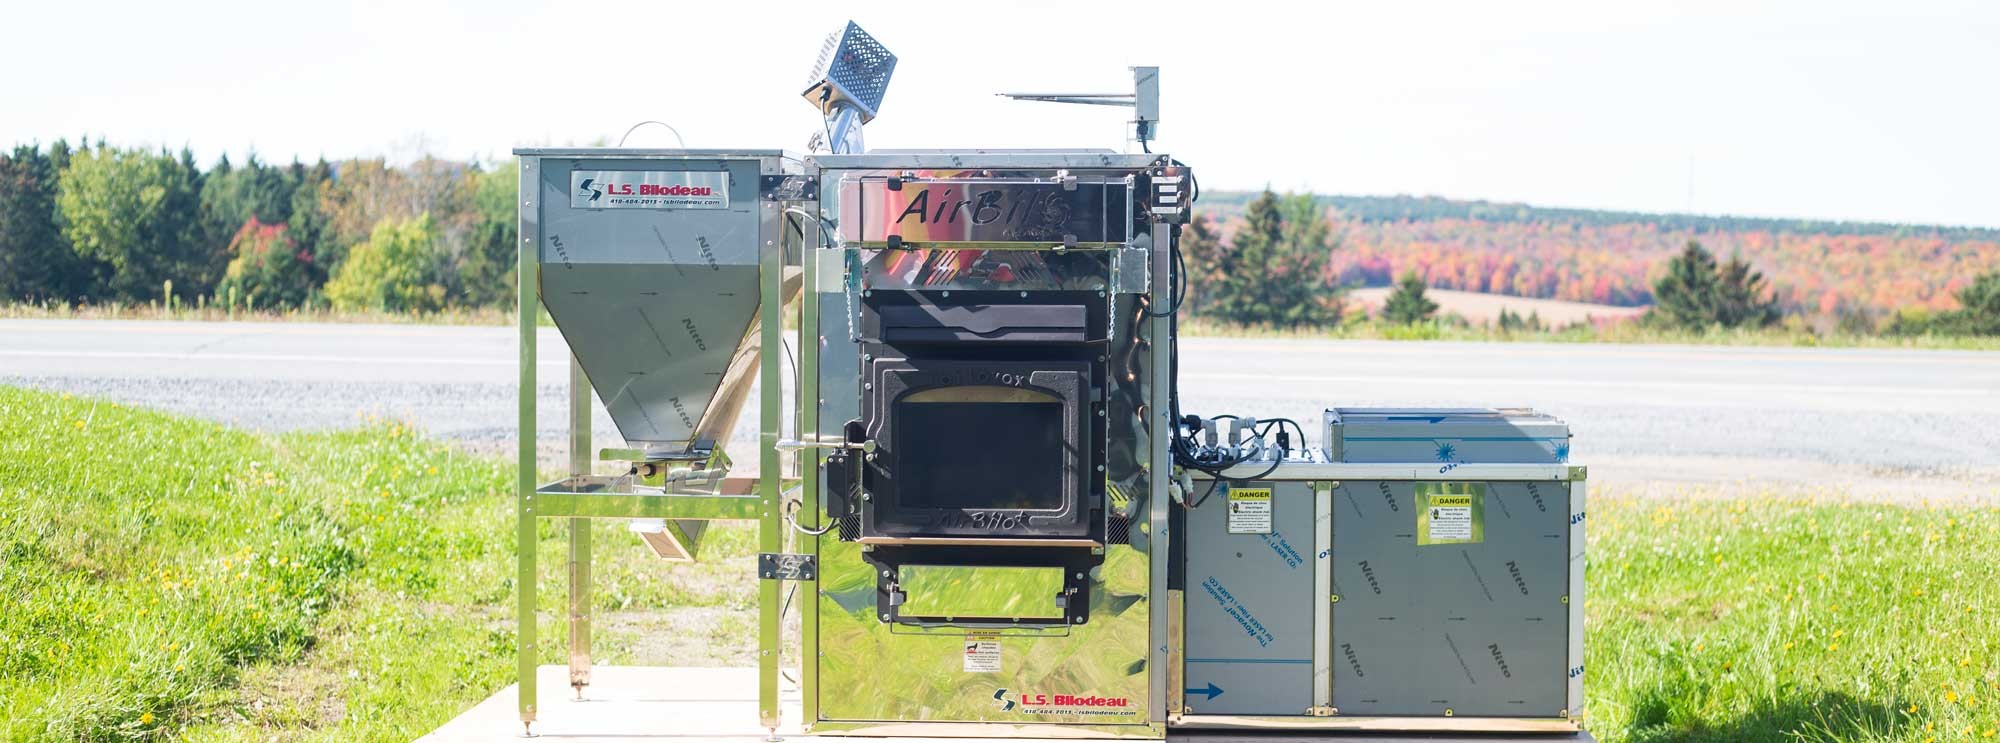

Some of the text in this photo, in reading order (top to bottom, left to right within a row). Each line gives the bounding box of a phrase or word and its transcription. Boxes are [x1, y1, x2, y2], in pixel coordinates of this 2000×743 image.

[608, 184, 711, 196] L.S. Bilodeau
[550, 234, 573, 270] Nitto
[698, 236, 719, 272] Nitto
[682, 318, 706, 352] Nitto
[668, 396, 694, 429] Nitto
[1280, 539, 1302, 564] Solution
[1202, 581, 1226, 605] Solution
[1358, 560, 1382, 595] Nitto
[1506, 560, 1528, 595] Nitto
[1341, 643, 1364, 678] Nitto
[1488, 643, 1512, 678] Nitto
[1022, 694, 1050, 706] L.S.
[1054, 695, 1127, 707] Bilodeau
